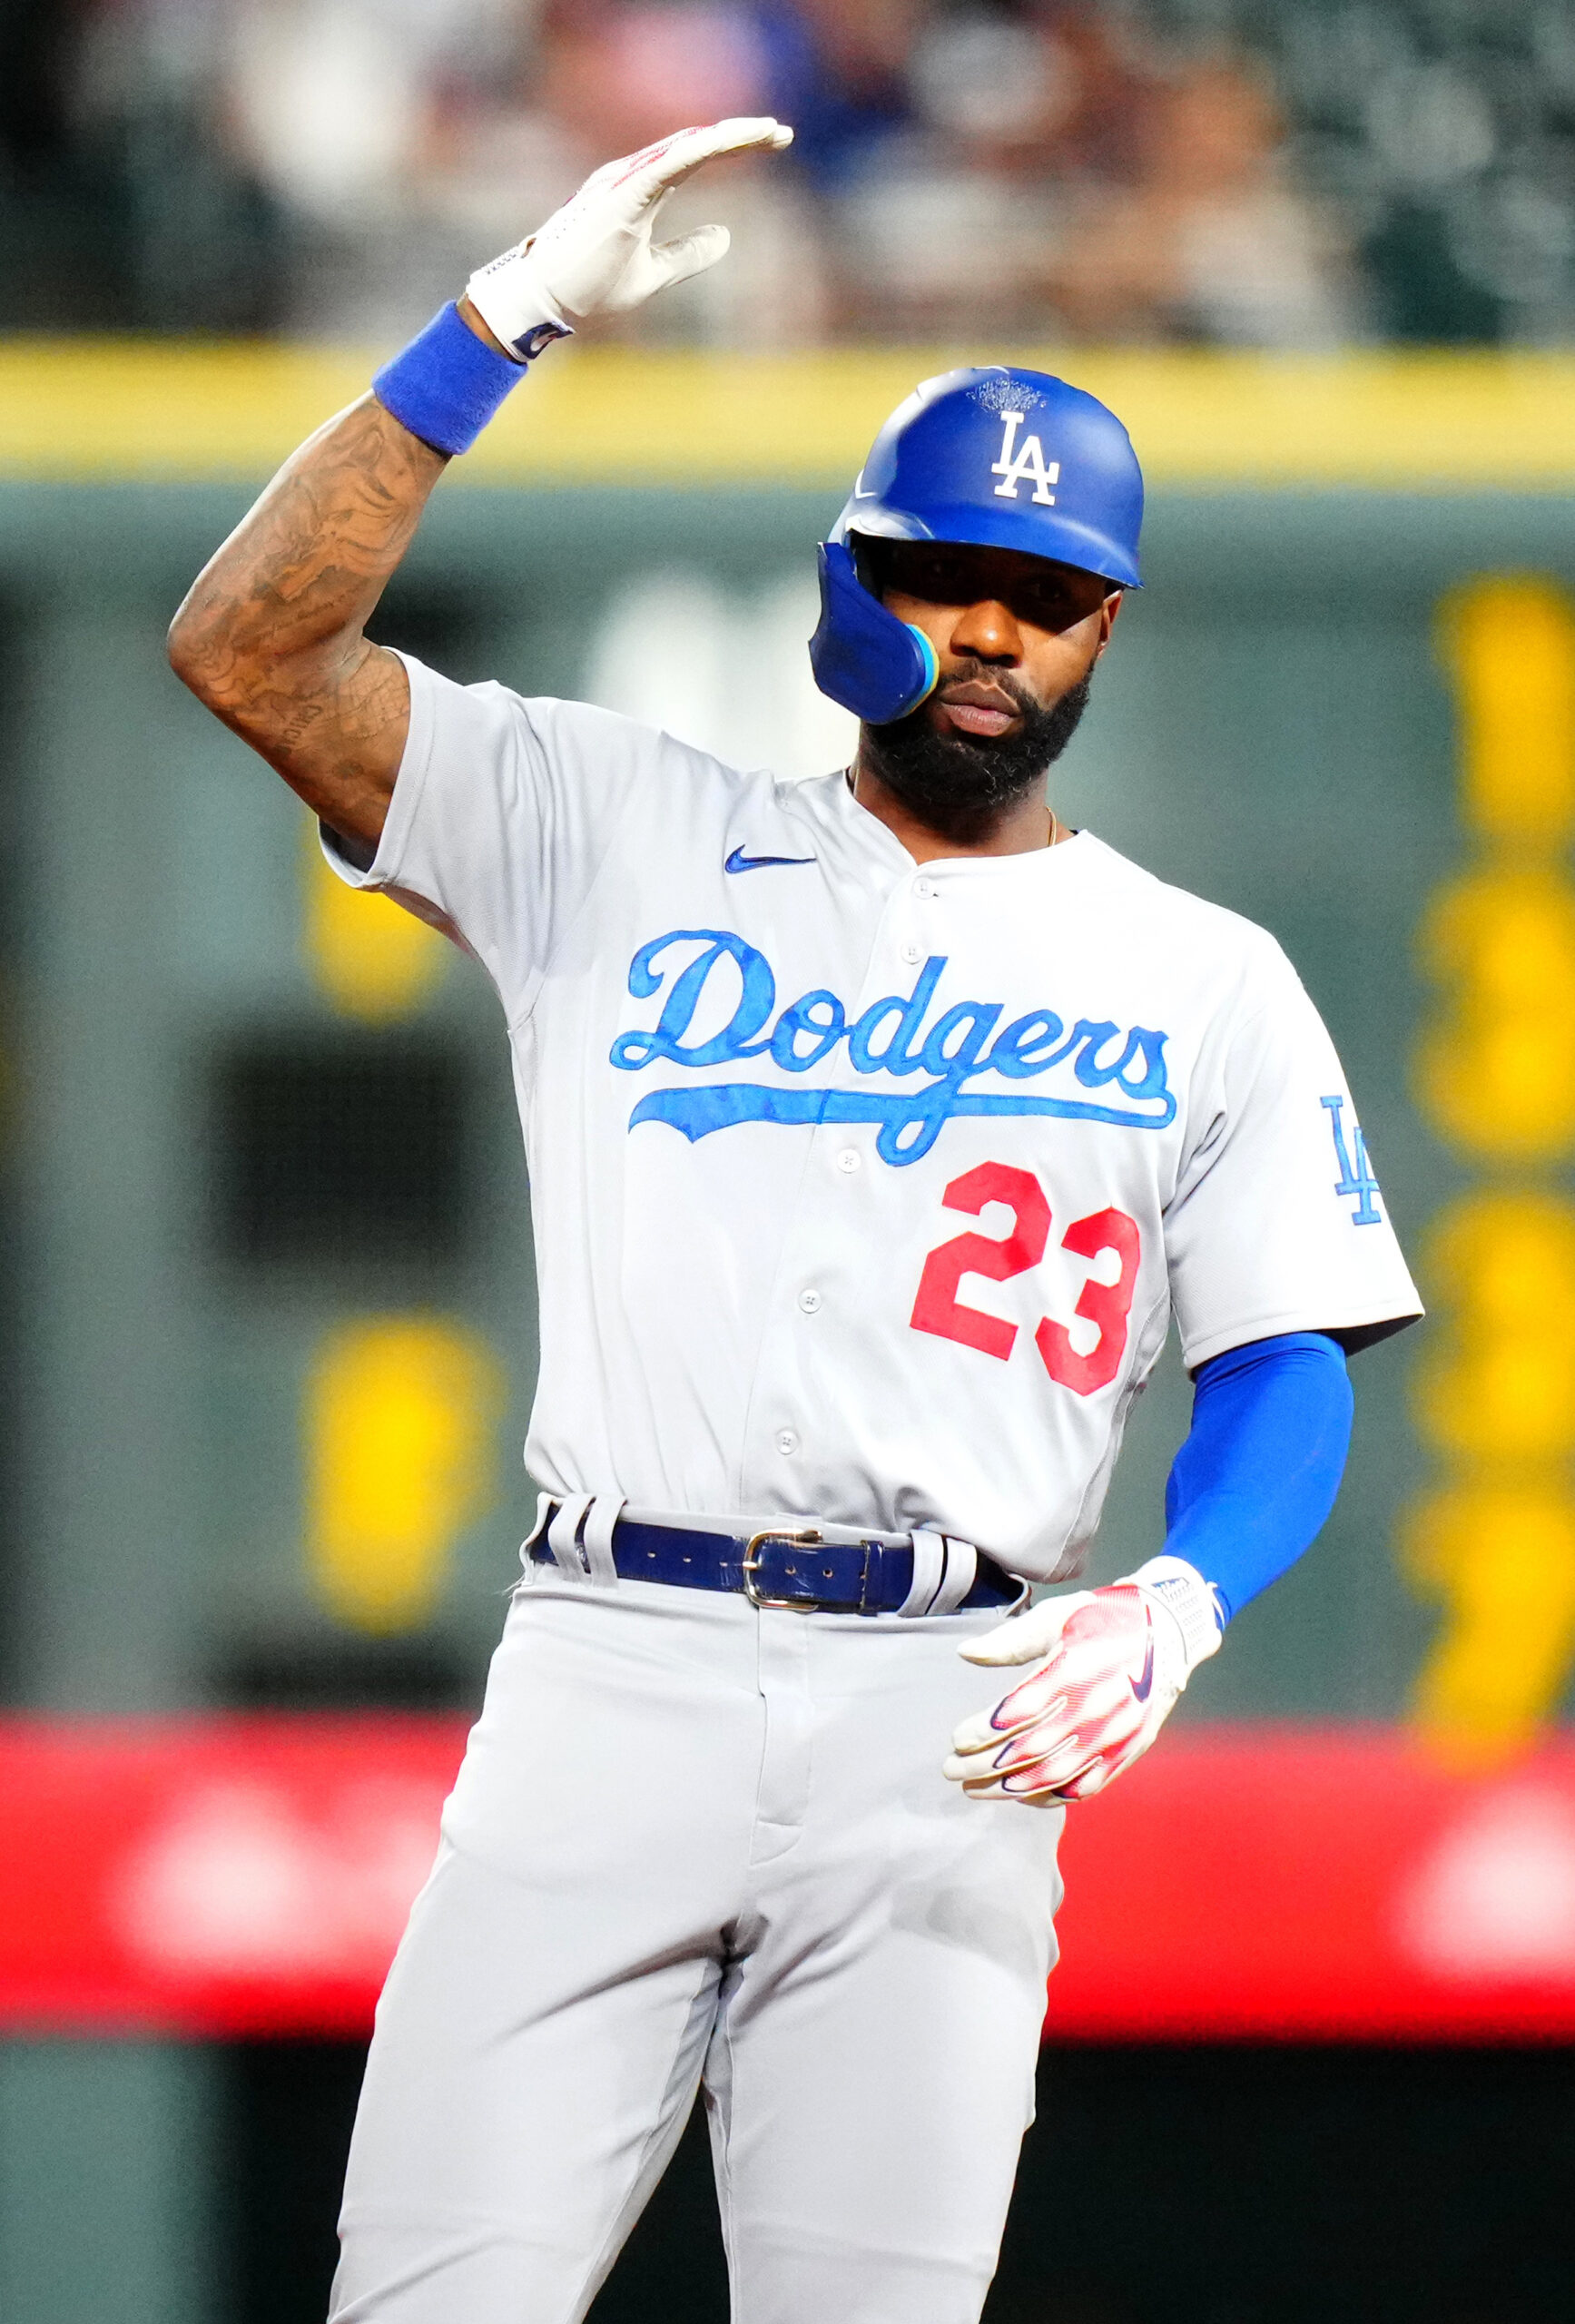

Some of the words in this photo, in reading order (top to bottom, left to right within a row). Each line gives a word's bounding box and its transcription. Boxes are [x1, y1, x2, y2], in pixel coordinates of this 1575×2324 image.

[990, 410, 1060, 506] LA
[609, 930, 1177, 1167] Dodgers
[909, 1160, 1141, 1397] 23
